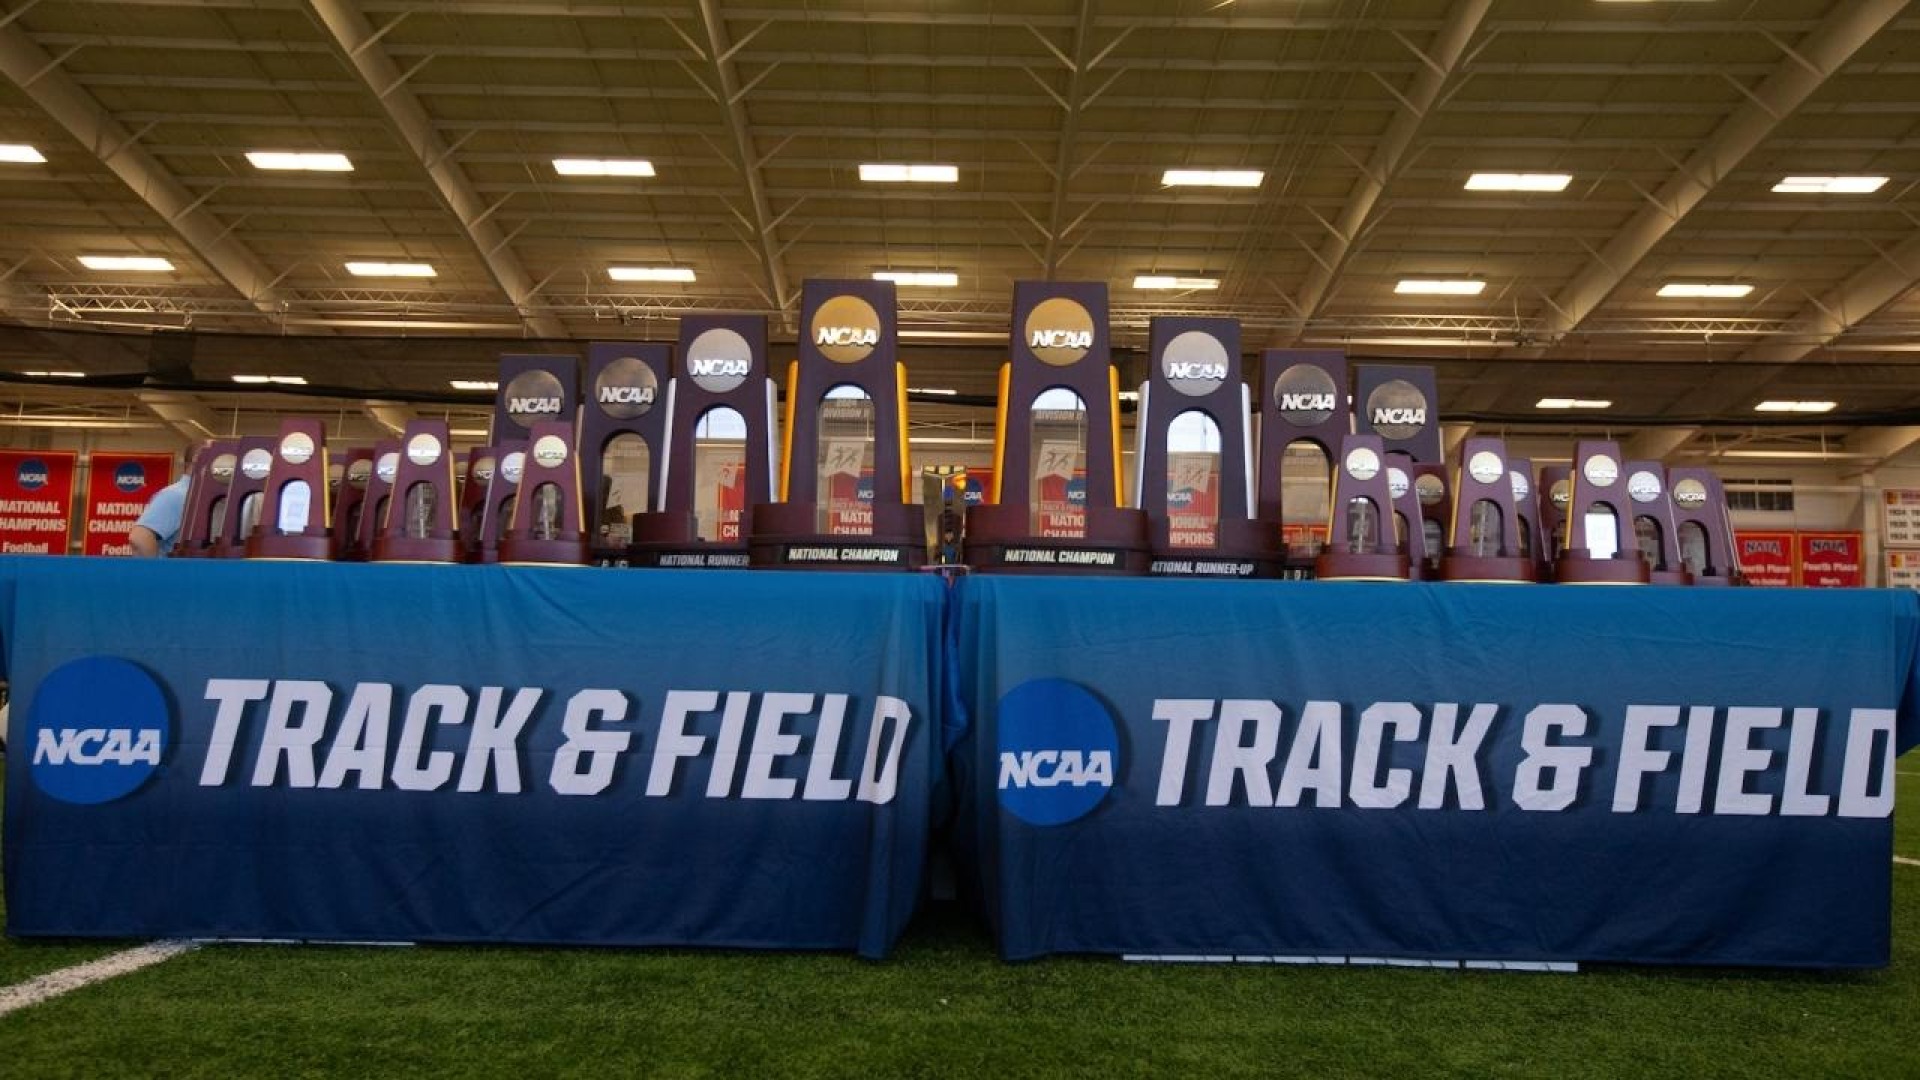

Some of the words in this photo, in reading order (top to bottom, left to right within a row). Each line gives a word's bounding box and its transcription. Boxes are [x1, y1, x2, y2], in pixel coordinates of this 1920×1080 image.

[817, 326, 878, 345] NCAA
[1032, 329, 1092, 348] NCAA
[692, 359, 749, 376] NCAA
[1168, 362, 1226, 379] NCAA
[600, 386, 654, 403] NCAA
[1281, 393, 1336, 411] NCAA
[509, 397, 562, 414] NCAA
[1373, 408, 1426, 424] NCAA
[964, 491, 982, 500] CAA
[0, 501, 61, 514] NATIONAL
[97, 503, 143, 516] NATION
[0, 519, 67, 532] HAMPIONS
[89, 519, 133, 533] CHAMP
[1050, 513, 1084, 526] NATIO
[659, 554, 705, 566] NATIONAL
[707, 555, 749, 567] RUNNER
[788, 548, 838, 561] NATIONAL
[840, 549, 898, 562] CHAMPION
[1004, 550, 1056, 562] NATIONAL
[1058, 551, 1115, 564] CHAMPION
[1151, 560, 1193, 574] ATIONAL
[1195, 562, 1254, 575] RUNNER-UP
[1741, 564, 1765, 573] ourth
[33, 728, 161, 765] NCAA
[199, 678, 543, 793] TRACK
[549, 689, 631, 796] &
[645, 689, 912, 804] FIELD
[1151, 698, 1499, 811] TRACK
[1511, 704, 1593, 811] &
[1611, 704, 1897, 818] FIELD
[999, 750, 1113, 789] NCAA
